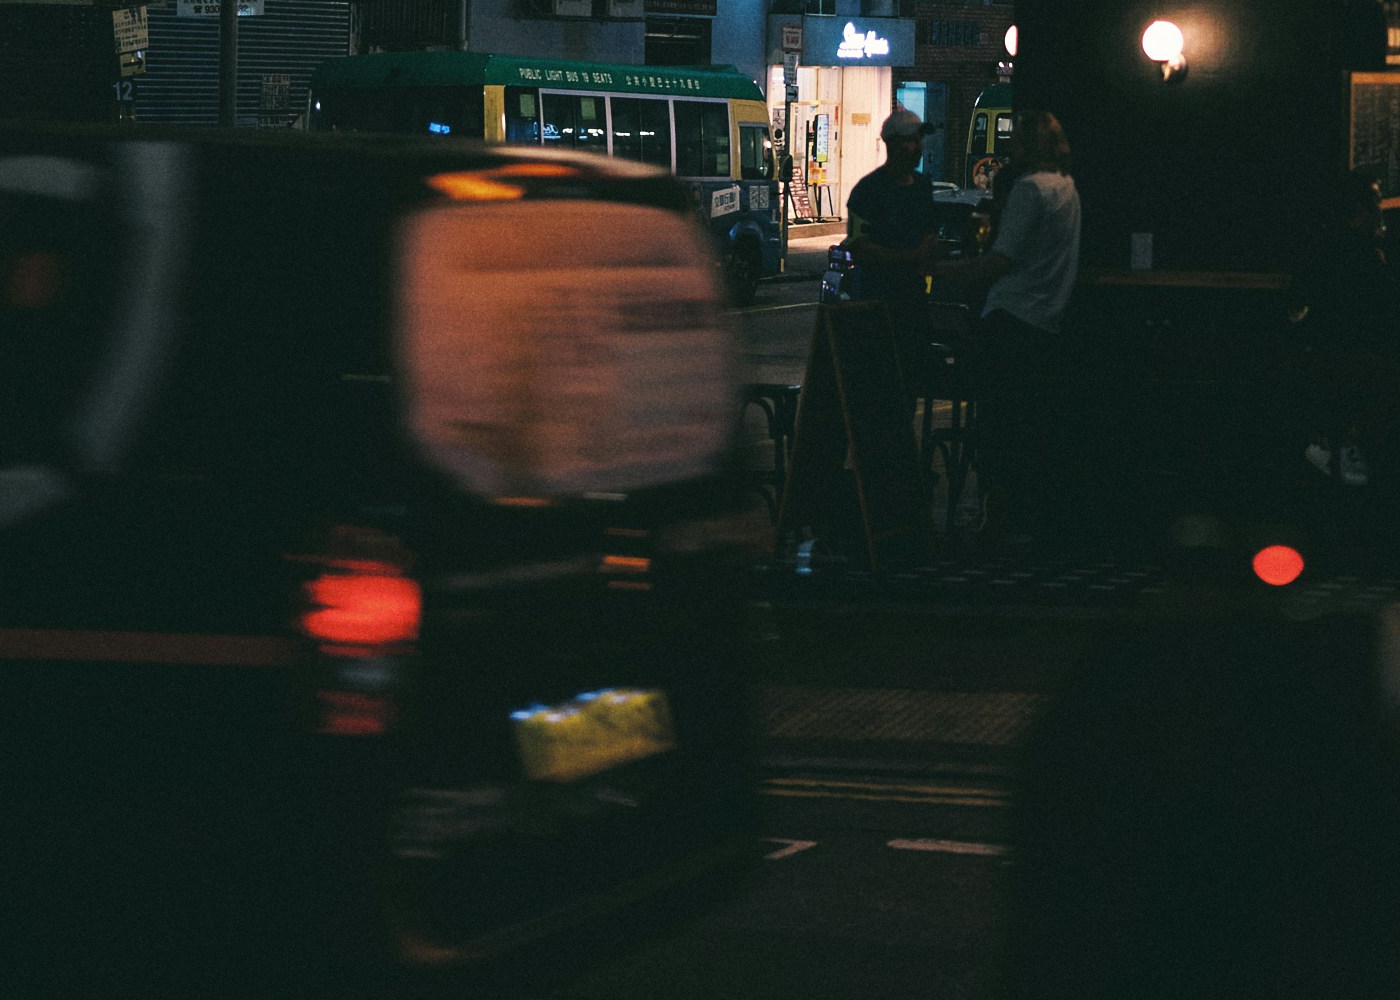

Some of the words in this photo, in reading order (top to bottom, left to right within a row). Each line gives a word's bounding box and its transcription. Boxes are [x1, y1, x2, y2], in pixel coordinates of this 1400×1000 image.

[519, 67, 542, 80] PUBLIC
[545, 69, 563, 82] LIGHT
[566, 71, 579, 83] BUS
[592, 72, 613, 84] SEATS
[113, 81, 133, 101] 12
